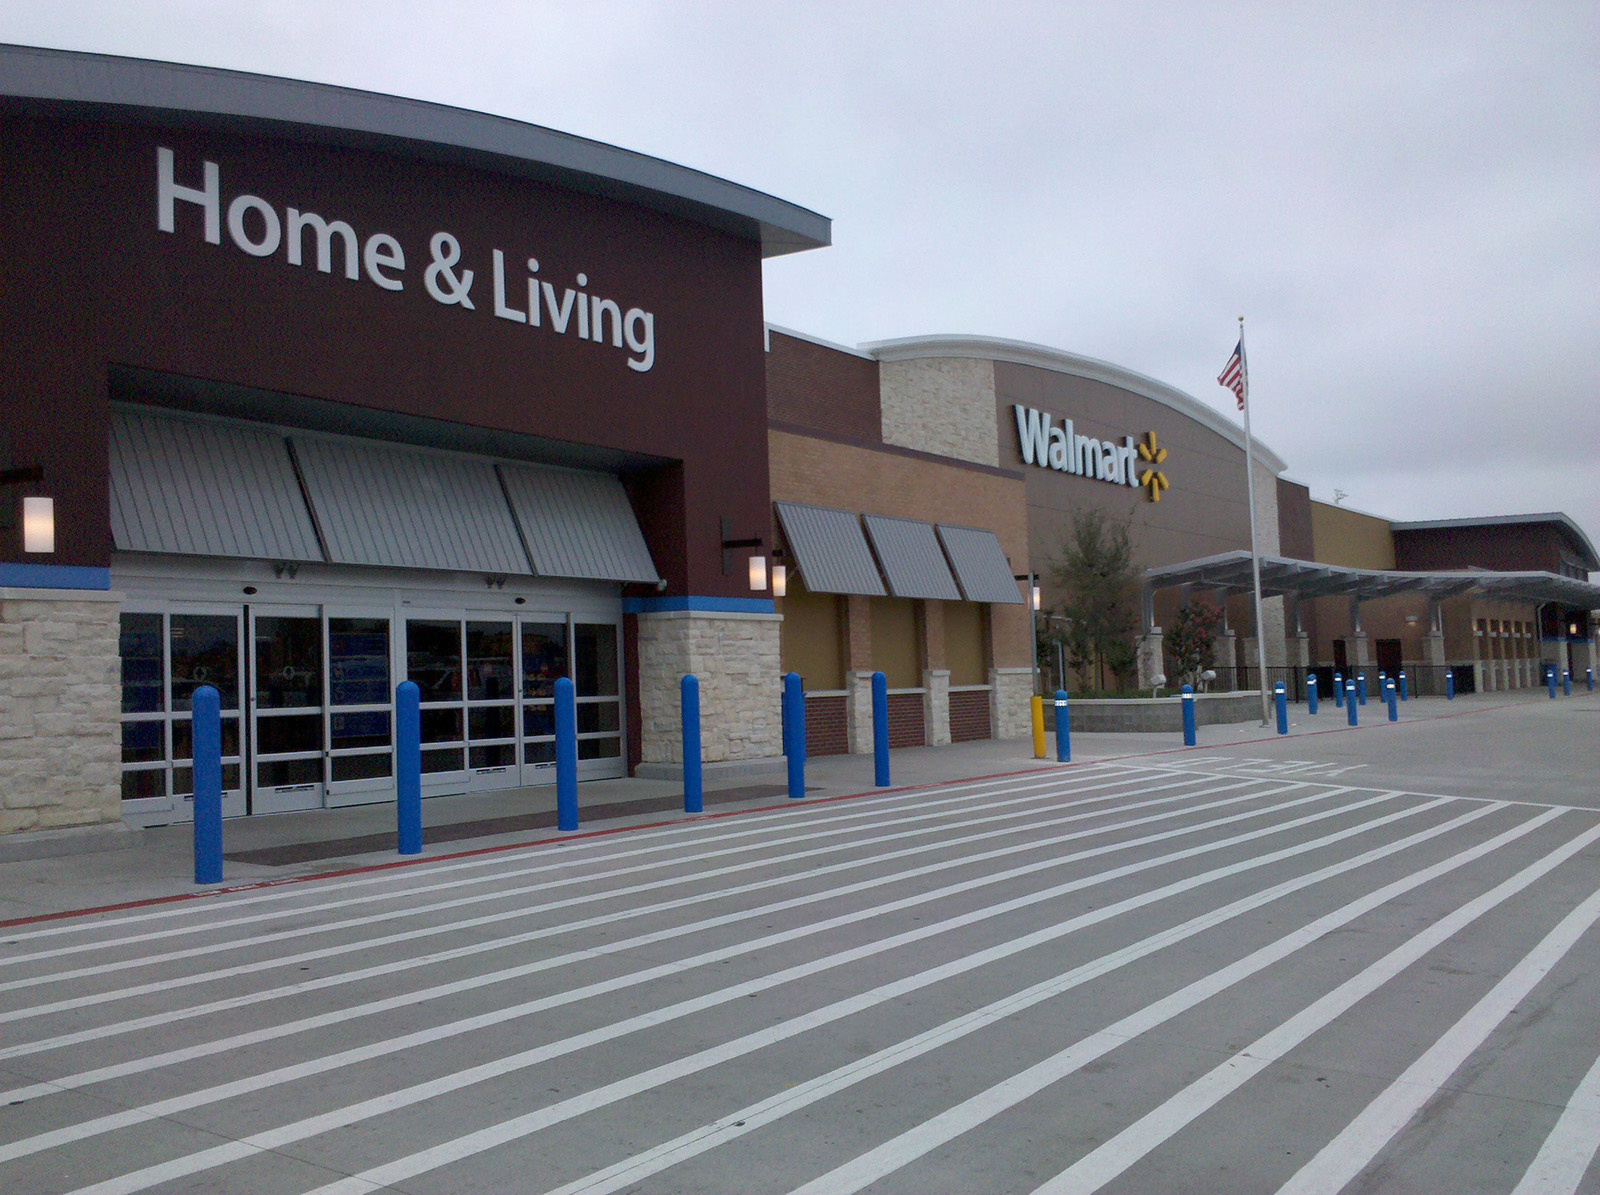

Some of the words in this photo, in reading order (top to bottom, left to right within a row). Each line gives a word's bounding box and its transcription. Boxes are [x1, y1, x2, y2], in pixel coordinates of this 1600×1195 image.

[156, 147, 406, 291] Home
[423, 232, 476, 310] &
[492, 248, 656, 373] Living
[1013, 404, 1140, 488] Walmart
